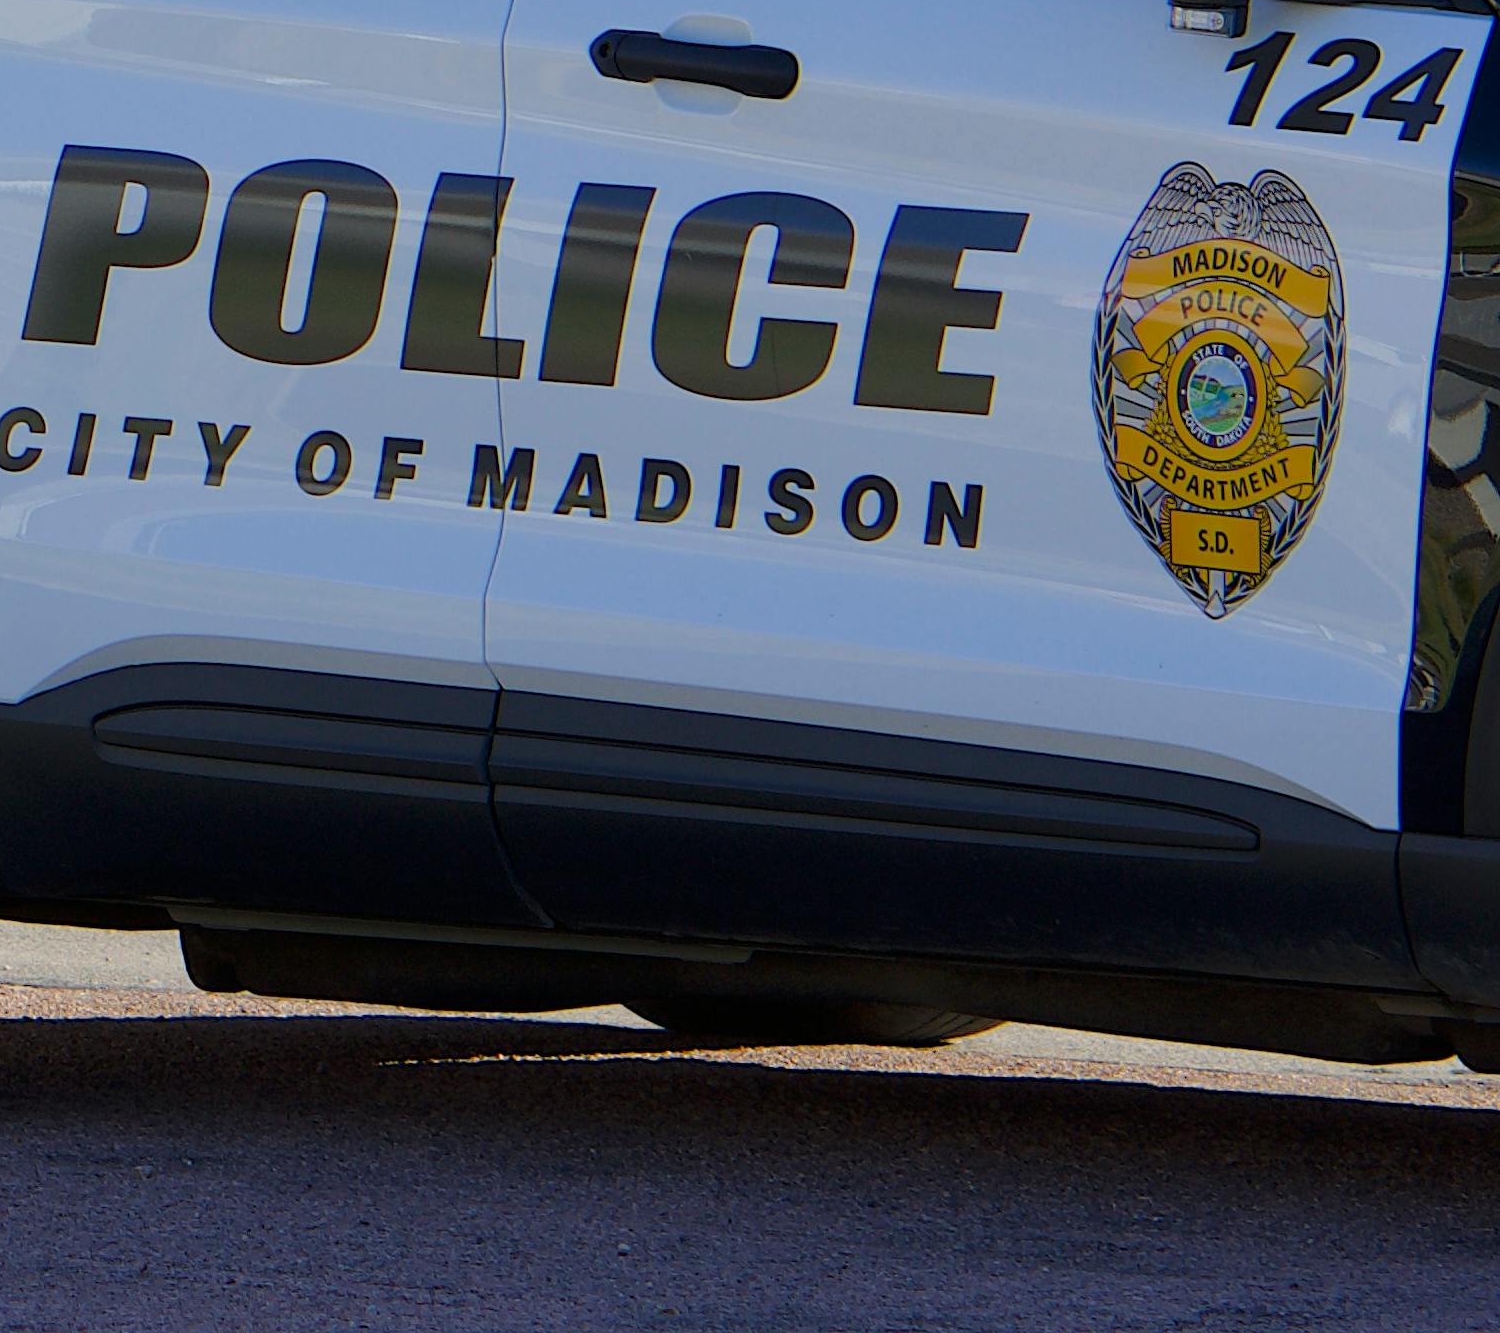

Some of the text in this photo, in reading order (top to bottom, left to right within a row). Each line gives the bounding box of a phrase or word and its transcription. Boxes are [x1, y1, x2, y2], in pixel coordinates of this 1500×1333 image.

[1224, 31, 1464, 142] 124
[21, 143, 1030, 416] POLICE
[1173, 247, 1287, 289] MADISON
[1181, 289, 1268, 327] POLICE
[1192, 344, 1249, 370] STATE OF
[1182, 410, 1253, 447] SOUTH DAKOTA
[295, 430, 424, 500] OF
[467, 443, 984, 549] MADISON
[1143, 445, 1290, 502] DEPARTMENT
[1198, 528, 1234, 555] S.D.
